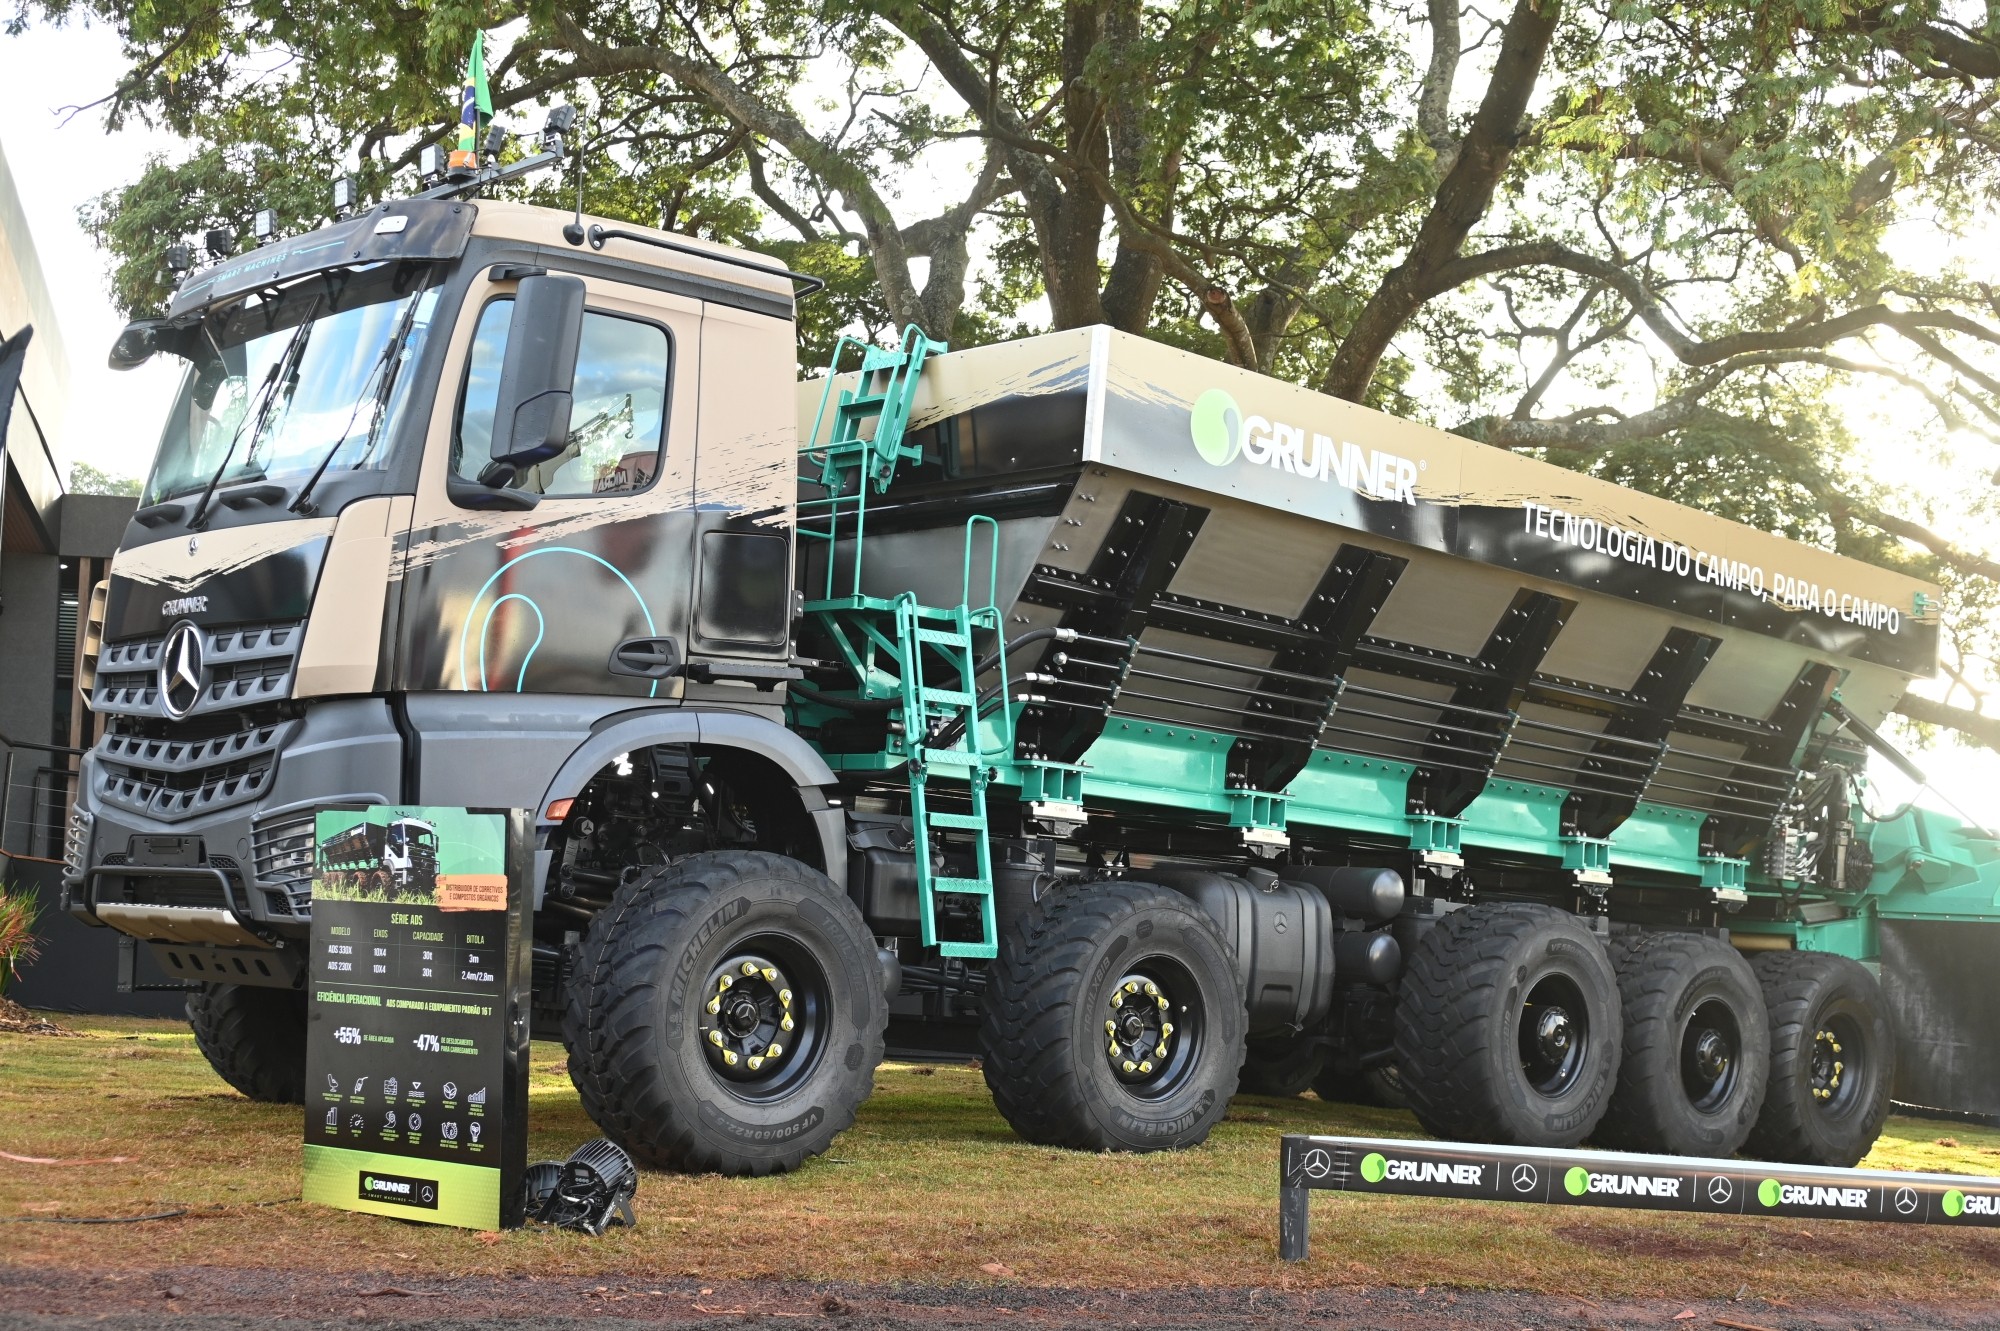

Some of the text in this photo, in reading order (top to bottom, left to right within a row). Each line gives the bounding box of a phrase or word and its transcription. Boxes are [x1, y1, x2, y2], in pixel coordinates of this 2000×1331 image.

[216, 253, 287, 283] SMART MACHINES
[1522, 502, 1900, 635] TECNOLOGIA DO CAMPO, PARA O CAMPO
[445, 884, 472, 892] DISTRIBUIDOR
[479, 886, 503, 894] CORRETIVOS
[477, 894, 499, 902] ORGÂNICOS
[391, 912, 423, 926] SÉRIE ADS
[330, 926, 351, 936] MODELO
[373, 929, 389, 939] EIXOS
[413, 931, 444, 942] CAPACIDADE
[466, 934, 485, 945] BITOLA
[328, 944, 338, 954] ADS
[373, 947, 387, 957] 10X4
[422, 951, 433, 961] 30t
[670, 899, 740, 1006] MICHELIN
[468, 953, 479, 963] 3m
[327, 961, 338, 970] ADS
[373, 964, 386, 974] 10X4
[422, 968, 432, 977] 30t
[316, 990, 382, 1006] EFICIÊNCIA OPERACIONAL
[1083, 956, 1111, 1034] TRAILXBIB
[386, 998, 396, 1008] ADS
[396, 999, 424, 1010] COMPARADO
[429, 1002, 461, 1013] EQUIPAMENTO
[461, 1004, 481, 1015] PADRÃO
[488, 1007, 492, 1016] T
[333, 1026, 362, 1044] +55%
[412, 1034, 440, 1053] -47%
[1552, 1073, 1606, 1131] MICHELIN
[1116, 1111, 1196, 1137] MICHELIN
[1384, 1159, 1482, 1185] GRUNNER
[373, 1180, 410, 1194] GRUNNER
[1587, 1173, 1680, 1197] GRUNNER
[1779, 1184, 1868, 1208] GRUNNER
[1963, 1194, 2000, 1215] GRU
